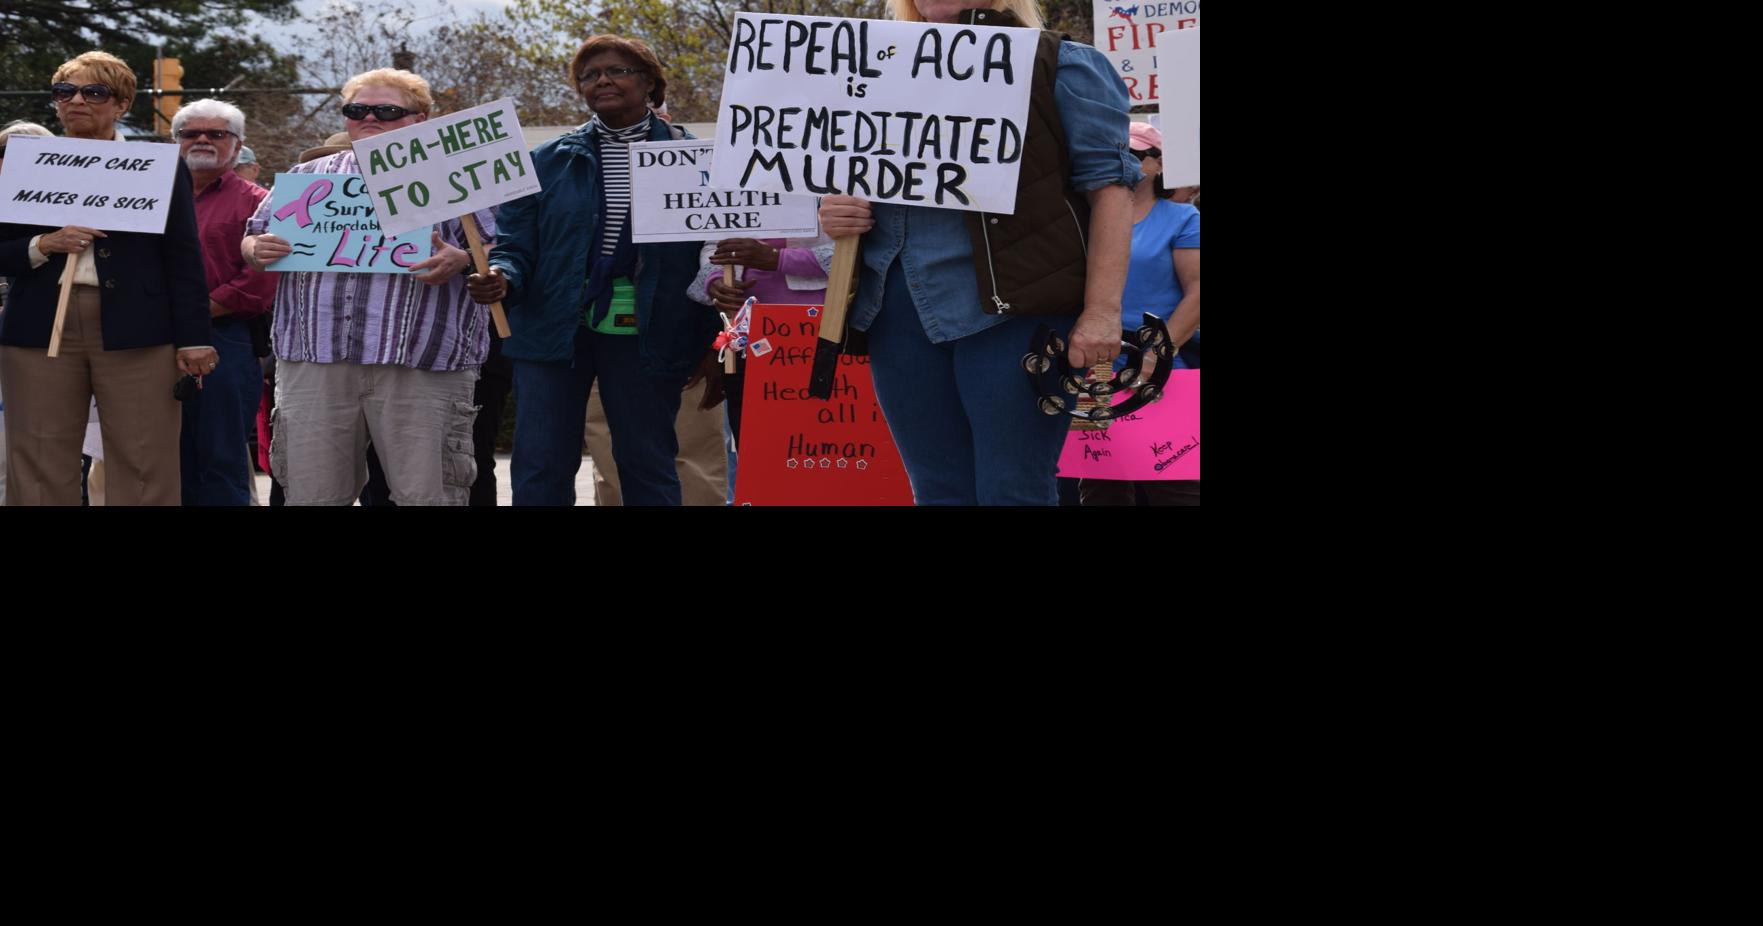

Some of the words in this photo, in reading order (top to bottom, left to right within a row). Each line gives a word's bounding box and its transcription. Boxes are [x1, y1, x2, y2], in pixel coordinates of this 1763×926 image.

[1145, 1, 1200, 17] DEMO
[729, 18, 882, 78] REPEAL
[911, 28, 1014, 85] ACA
[846, 76, 867, 98] is
[370, 110, 508, 175] ACA-HERE
[729, 104, 1022, 164] PREMEDITATED
[34, 153, 101, 168] TRUMP
[105, 157, 155, 171] CARE
[378, 180, 430, 216] TO
[447, 150, 526, 204] STAY
[740, 149, 970, 205] MURDER
[12, 189, 78, 205] MAKES
[82, 194, 109, 207] US
[113, 197, 158, 210] SICK
[323, 201, 375, 217] Surv
[663, 190, 782, 209] HEALTH
[685, 212, 761, 230] CARE
[818, 403, 855, 424] all
[787, 433, 875, 458] Human
